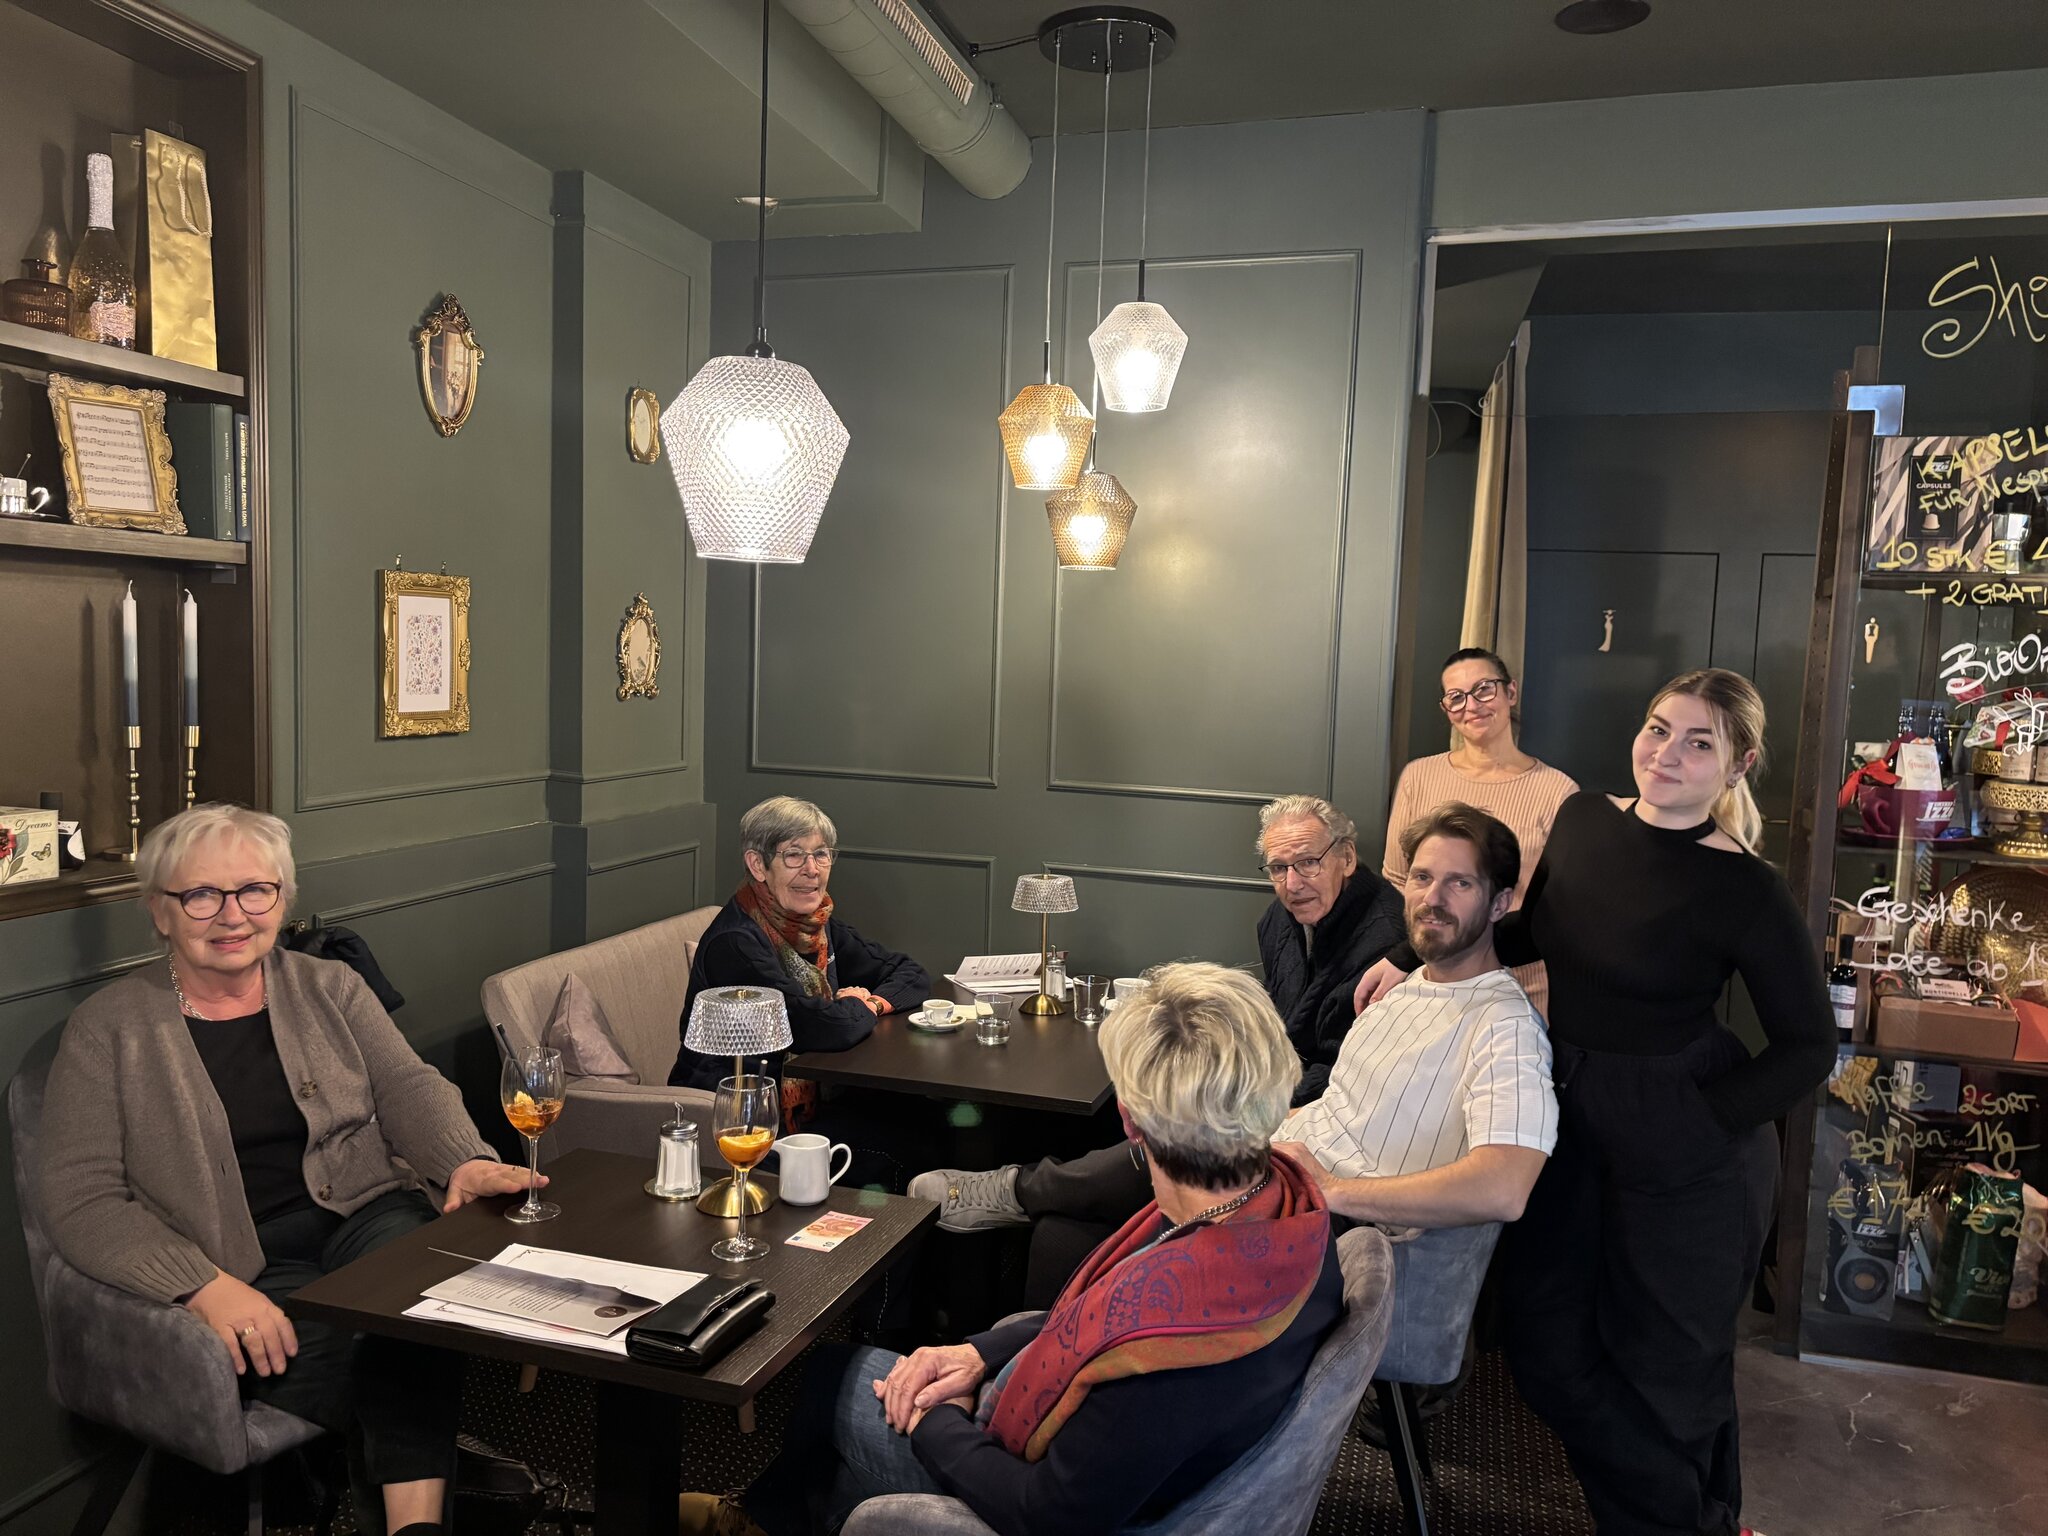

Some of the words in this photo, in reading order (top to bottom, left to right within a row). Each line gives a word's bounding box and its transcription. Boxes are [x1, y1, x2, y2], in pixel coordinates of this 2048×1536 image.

[1915, 424, 2048, 484] KAPSEL
[1876, 535, 1918, 569] 10
[1942, 579, 1967, 607] 2
[15, 818, 53, 831] Dreams
